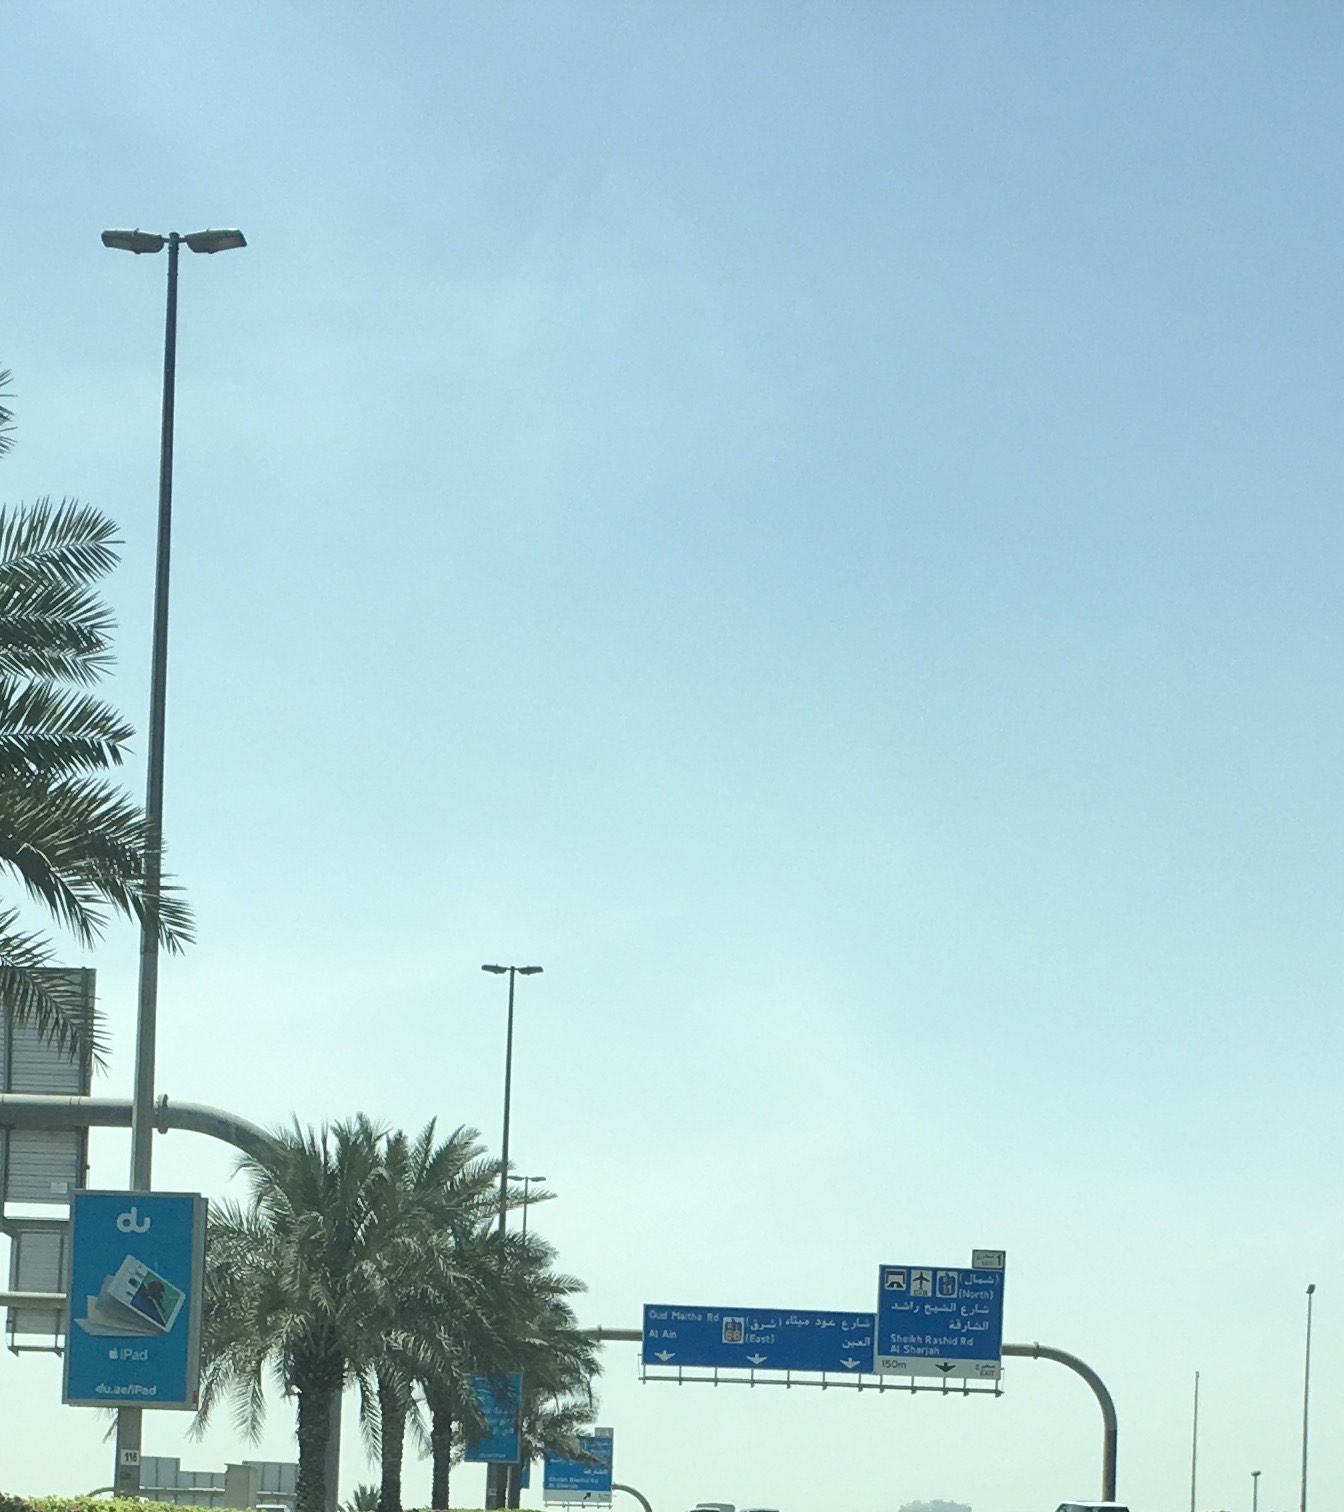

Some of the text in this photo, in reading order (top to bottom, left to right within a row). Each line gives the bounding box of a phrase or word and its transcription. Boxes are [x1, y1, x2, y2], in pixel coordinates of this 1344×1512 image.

[116, 1206, 151, 1234] du
[924, 1302, 956, 1315] الشيخ
[961, 1303, 990, 1316] شارع
[648, 1309, 668, 1320] Oud
[706, 1312, 719, 1322] Rd
[841, 1317, 871, 1331] شارع
[948, 1318, 989, 1332] الشارقة
[648, 1329, 677, 1339] Al Ain
[745, 1333, 775, 1344] (East)
[890, 1333, 974, 1346] Sheikh Rashid Rd
[842, 1336, 871, 1348] العين
[120, 1348, 148, 1360] iPad
[890, 1344, 900, 1354] Al
[881, 1359, 907, 1369] 150m
